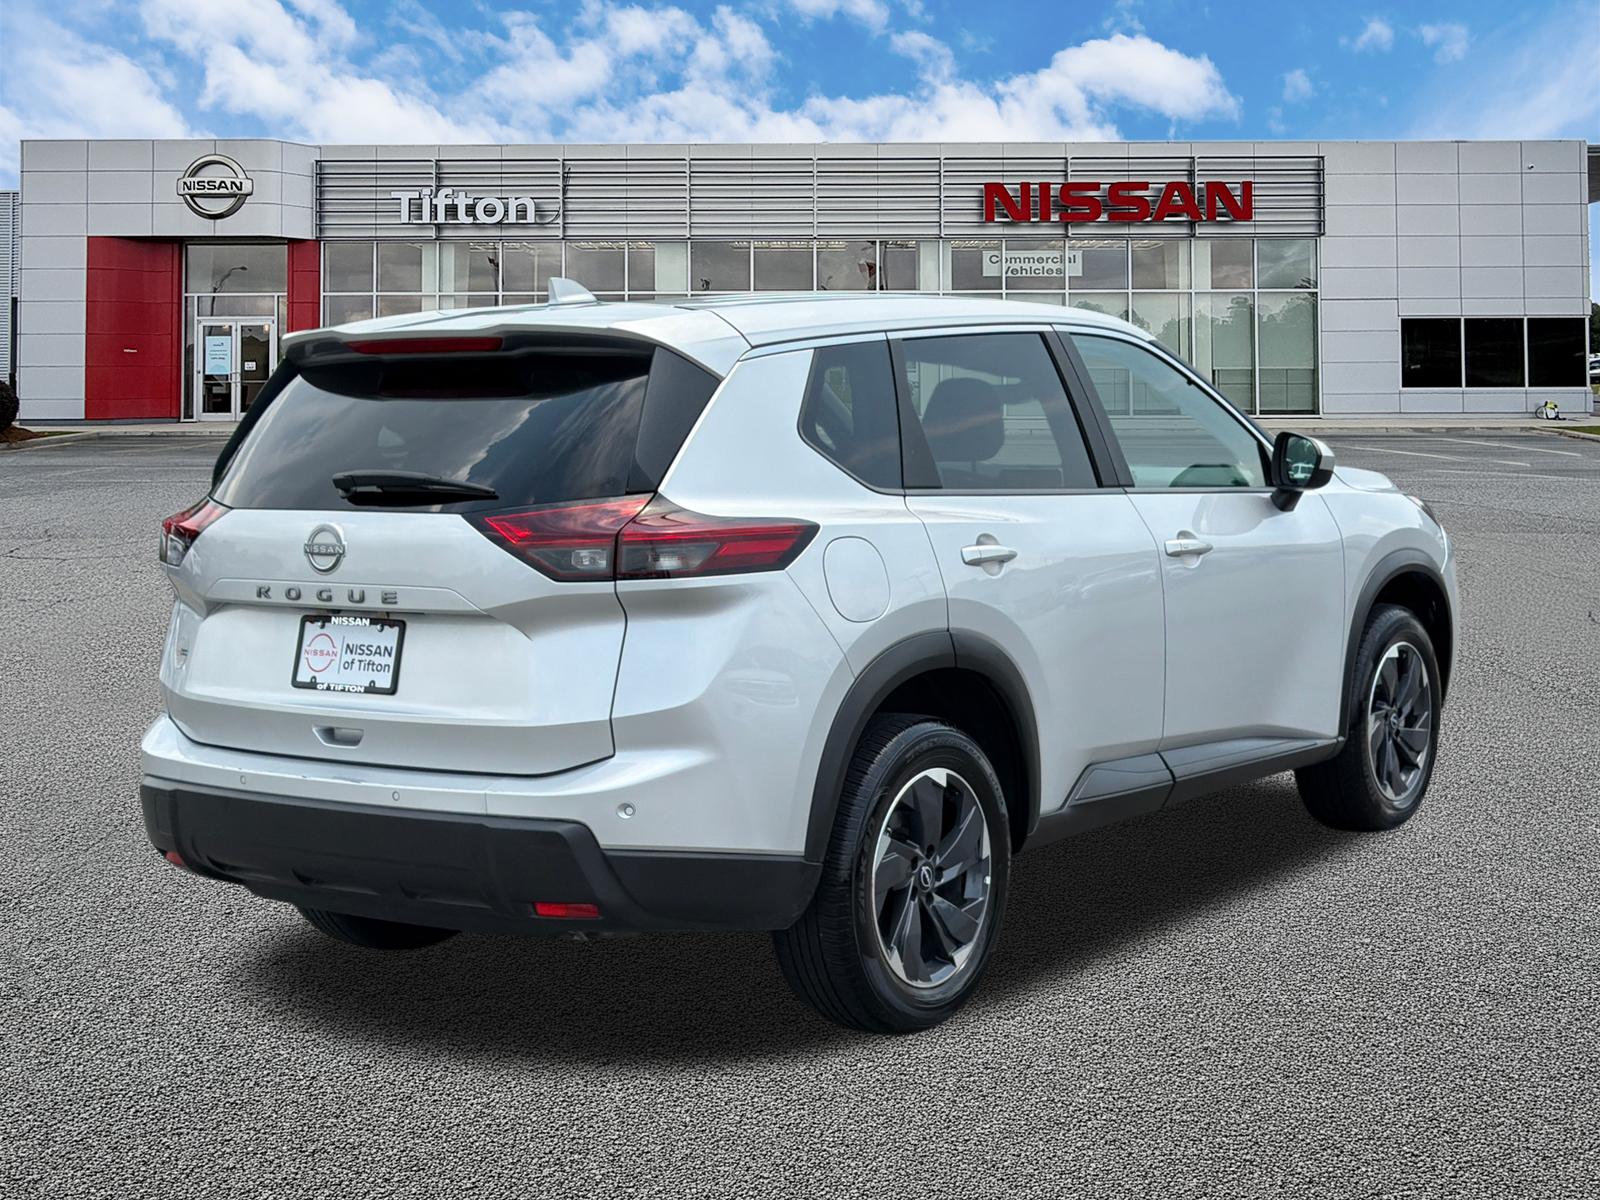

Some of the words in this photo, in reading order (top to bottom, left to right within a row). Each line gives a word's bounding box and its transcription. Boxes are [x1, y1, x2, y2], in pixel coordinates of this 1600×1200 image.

[183, 180, 243, 192] NISSAN
[391, 188, 536, 224] Tifton
[984, 181, 1253, 222] NISSAN
[304, 543, 345, 555] NISSAN
[256, 585, 398, 605] ROGUE
[330, 616, 370, 627] NISSAN
[304, 648, 338, 657] NISSAN
[345, 643, 393, 658] NISSAN
[343, 659, 356, 671] of
[357, 660, 391, 674] Tifton
[316, 682, 328, 690] of
[329, 683, 365, 693] TIFTON
